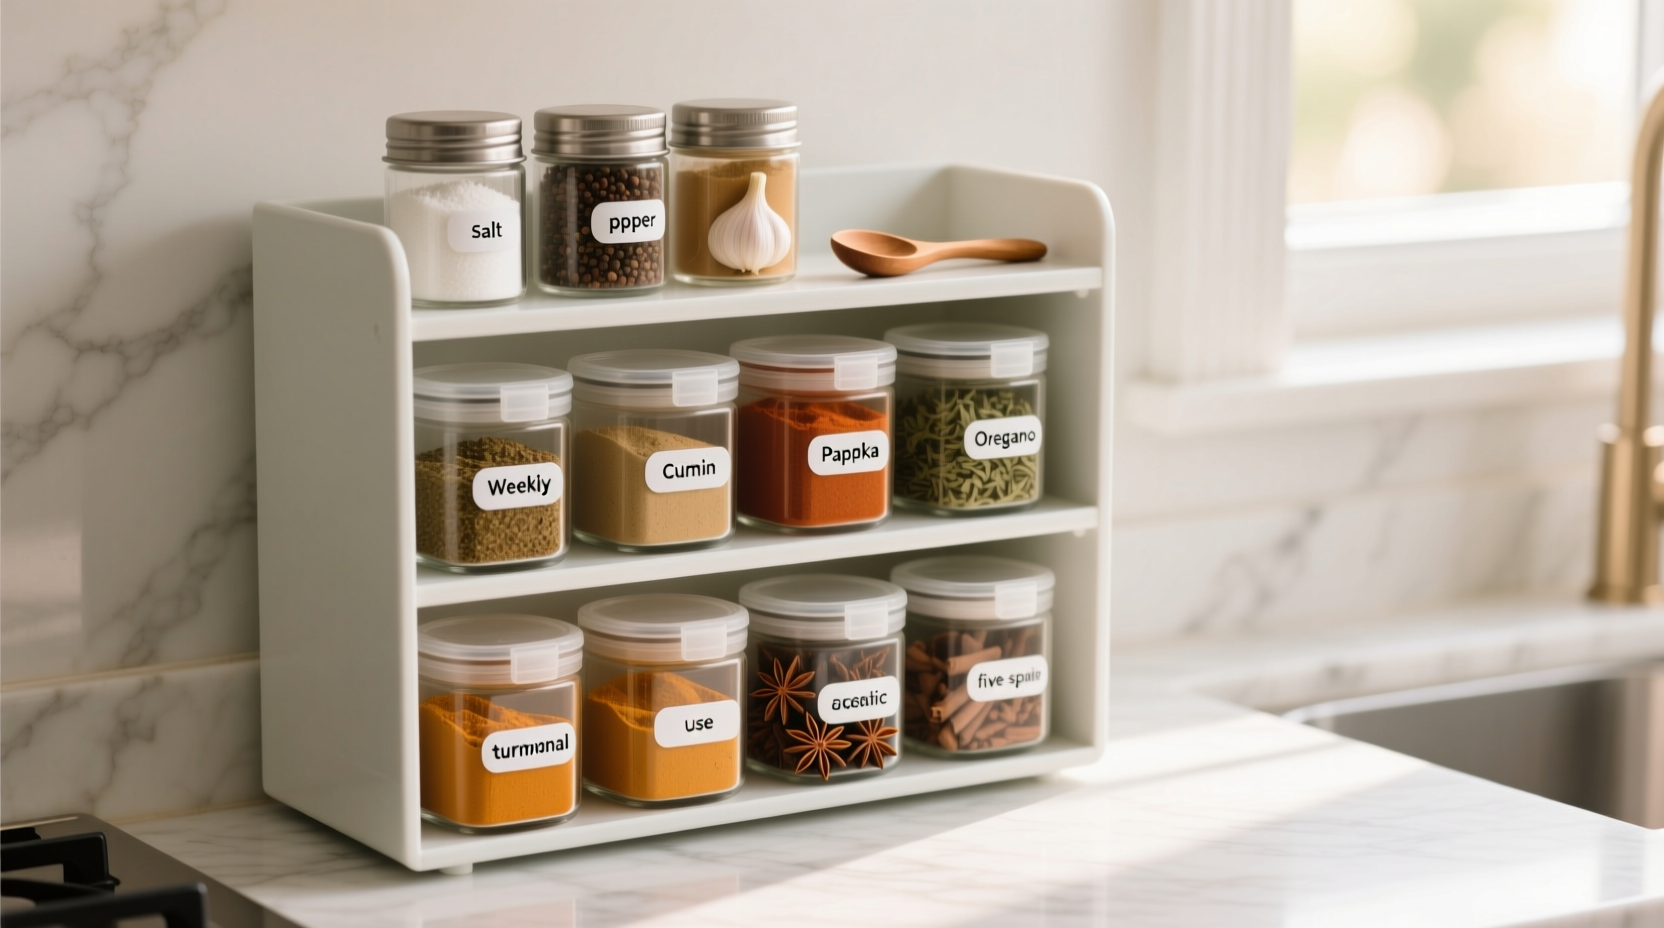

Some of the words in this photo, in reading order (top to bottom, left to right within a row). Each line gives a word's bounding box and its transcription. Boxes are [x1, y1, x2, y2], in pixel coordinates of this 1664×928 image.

[471, 220, 503, 239] Salt
[609, 215, 656, 234] ppper
[974, 430, 1037, 450] Oregano
[661, 458, 717, 480] Cumin
[978, 673, 1005, 689] five
[684, 717, 714, 733] use
